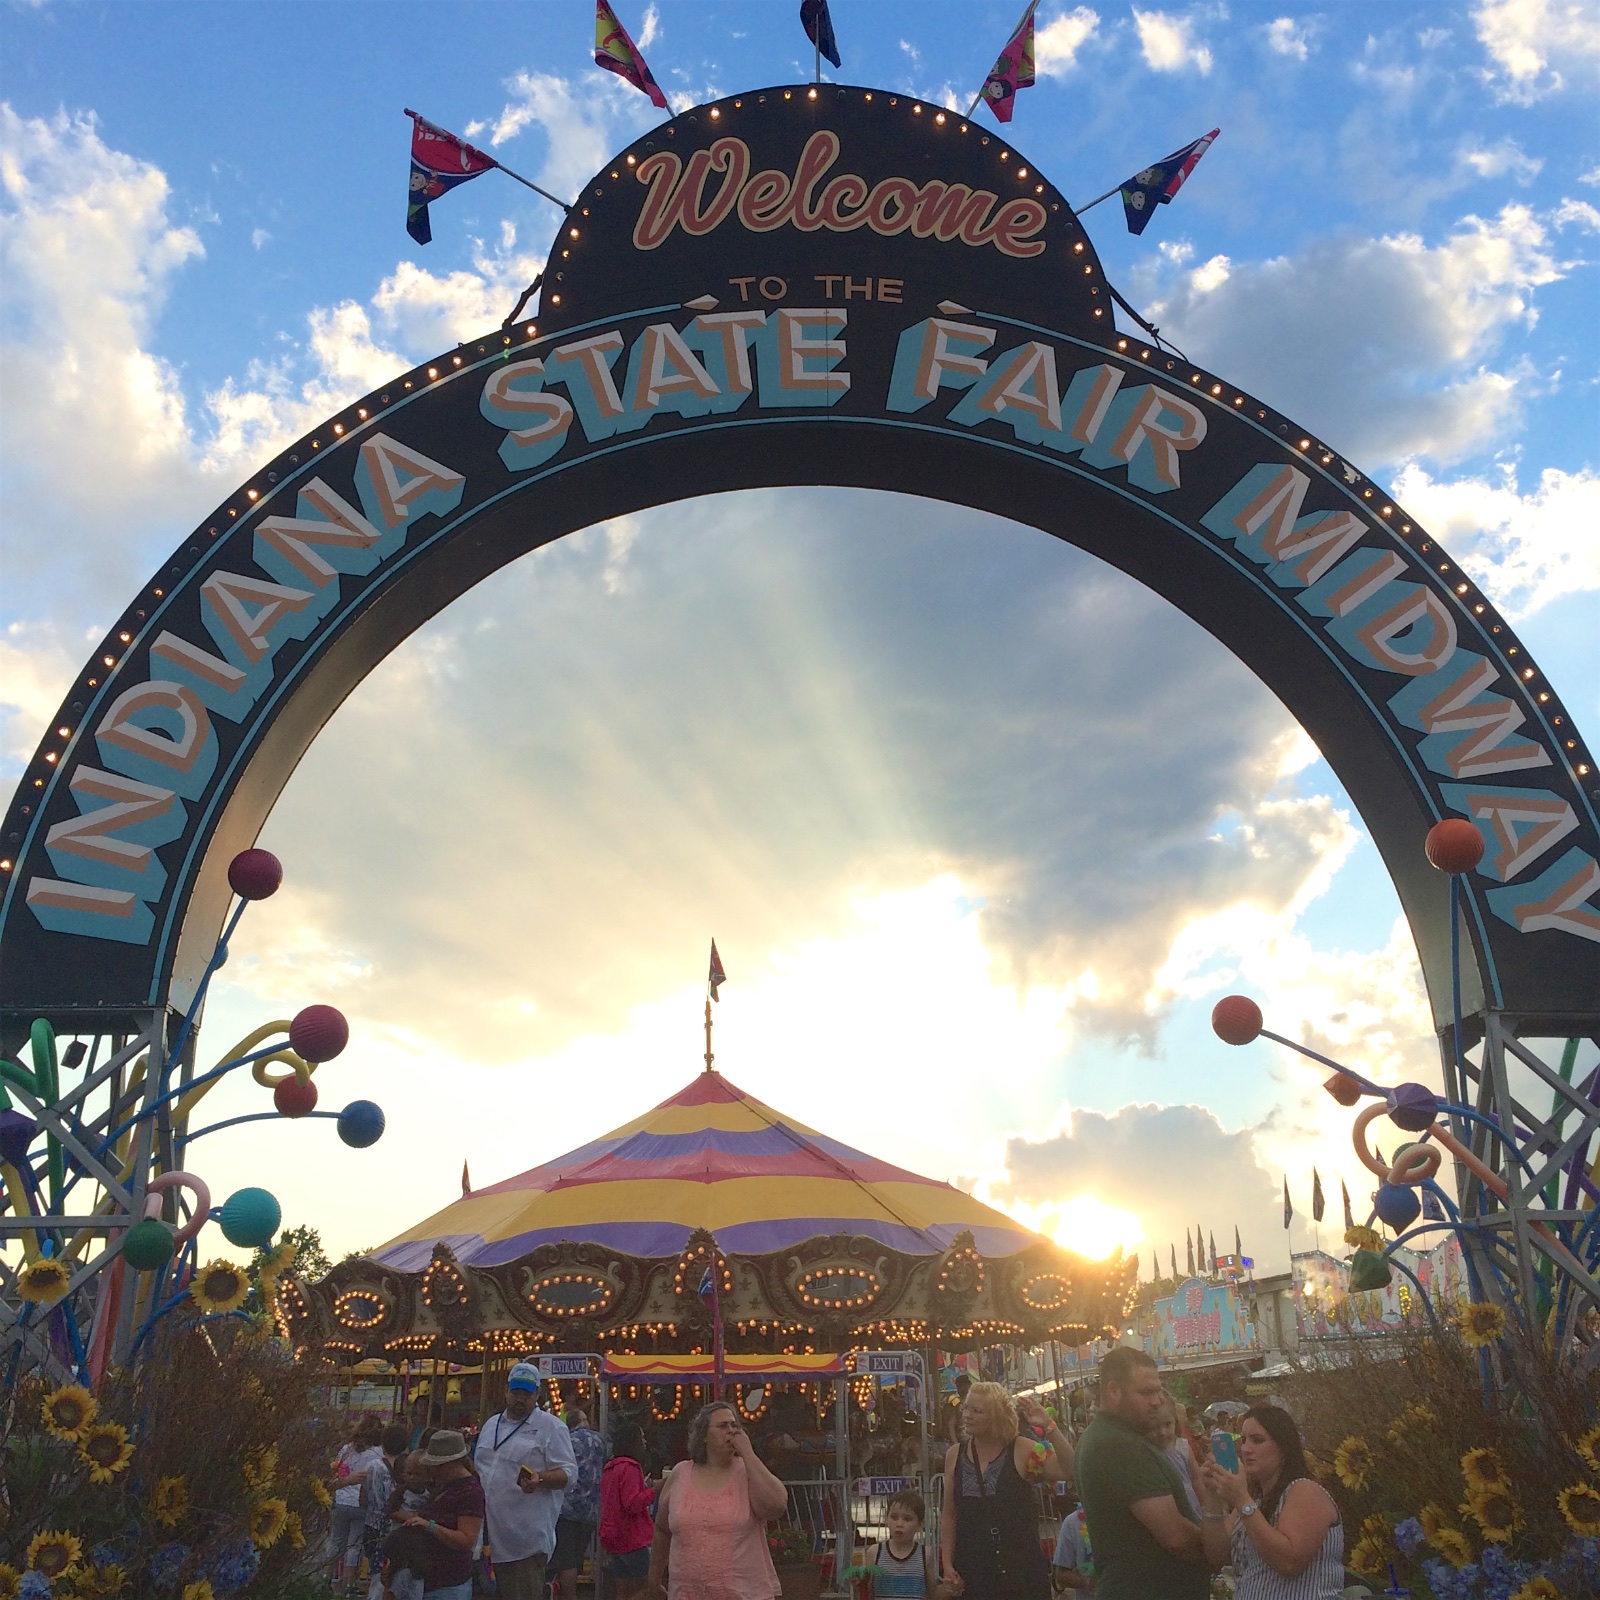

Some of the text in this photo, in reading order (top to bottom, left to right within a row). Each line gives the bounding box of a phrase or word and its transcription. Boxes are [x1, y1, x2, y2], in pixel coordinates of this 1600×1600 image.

[633, 129, 1048, 258] Welcome
[729, 275, 905, 303] TO THE
[25, 307, 1600, 945] INDIANA STATE FAIR MIDWAY
[552, 1359, 586, 1373] ENTRANCE
[873, 1357, 900, 1371] EXIT
[875, 1480, 903, 1495] EXIT
